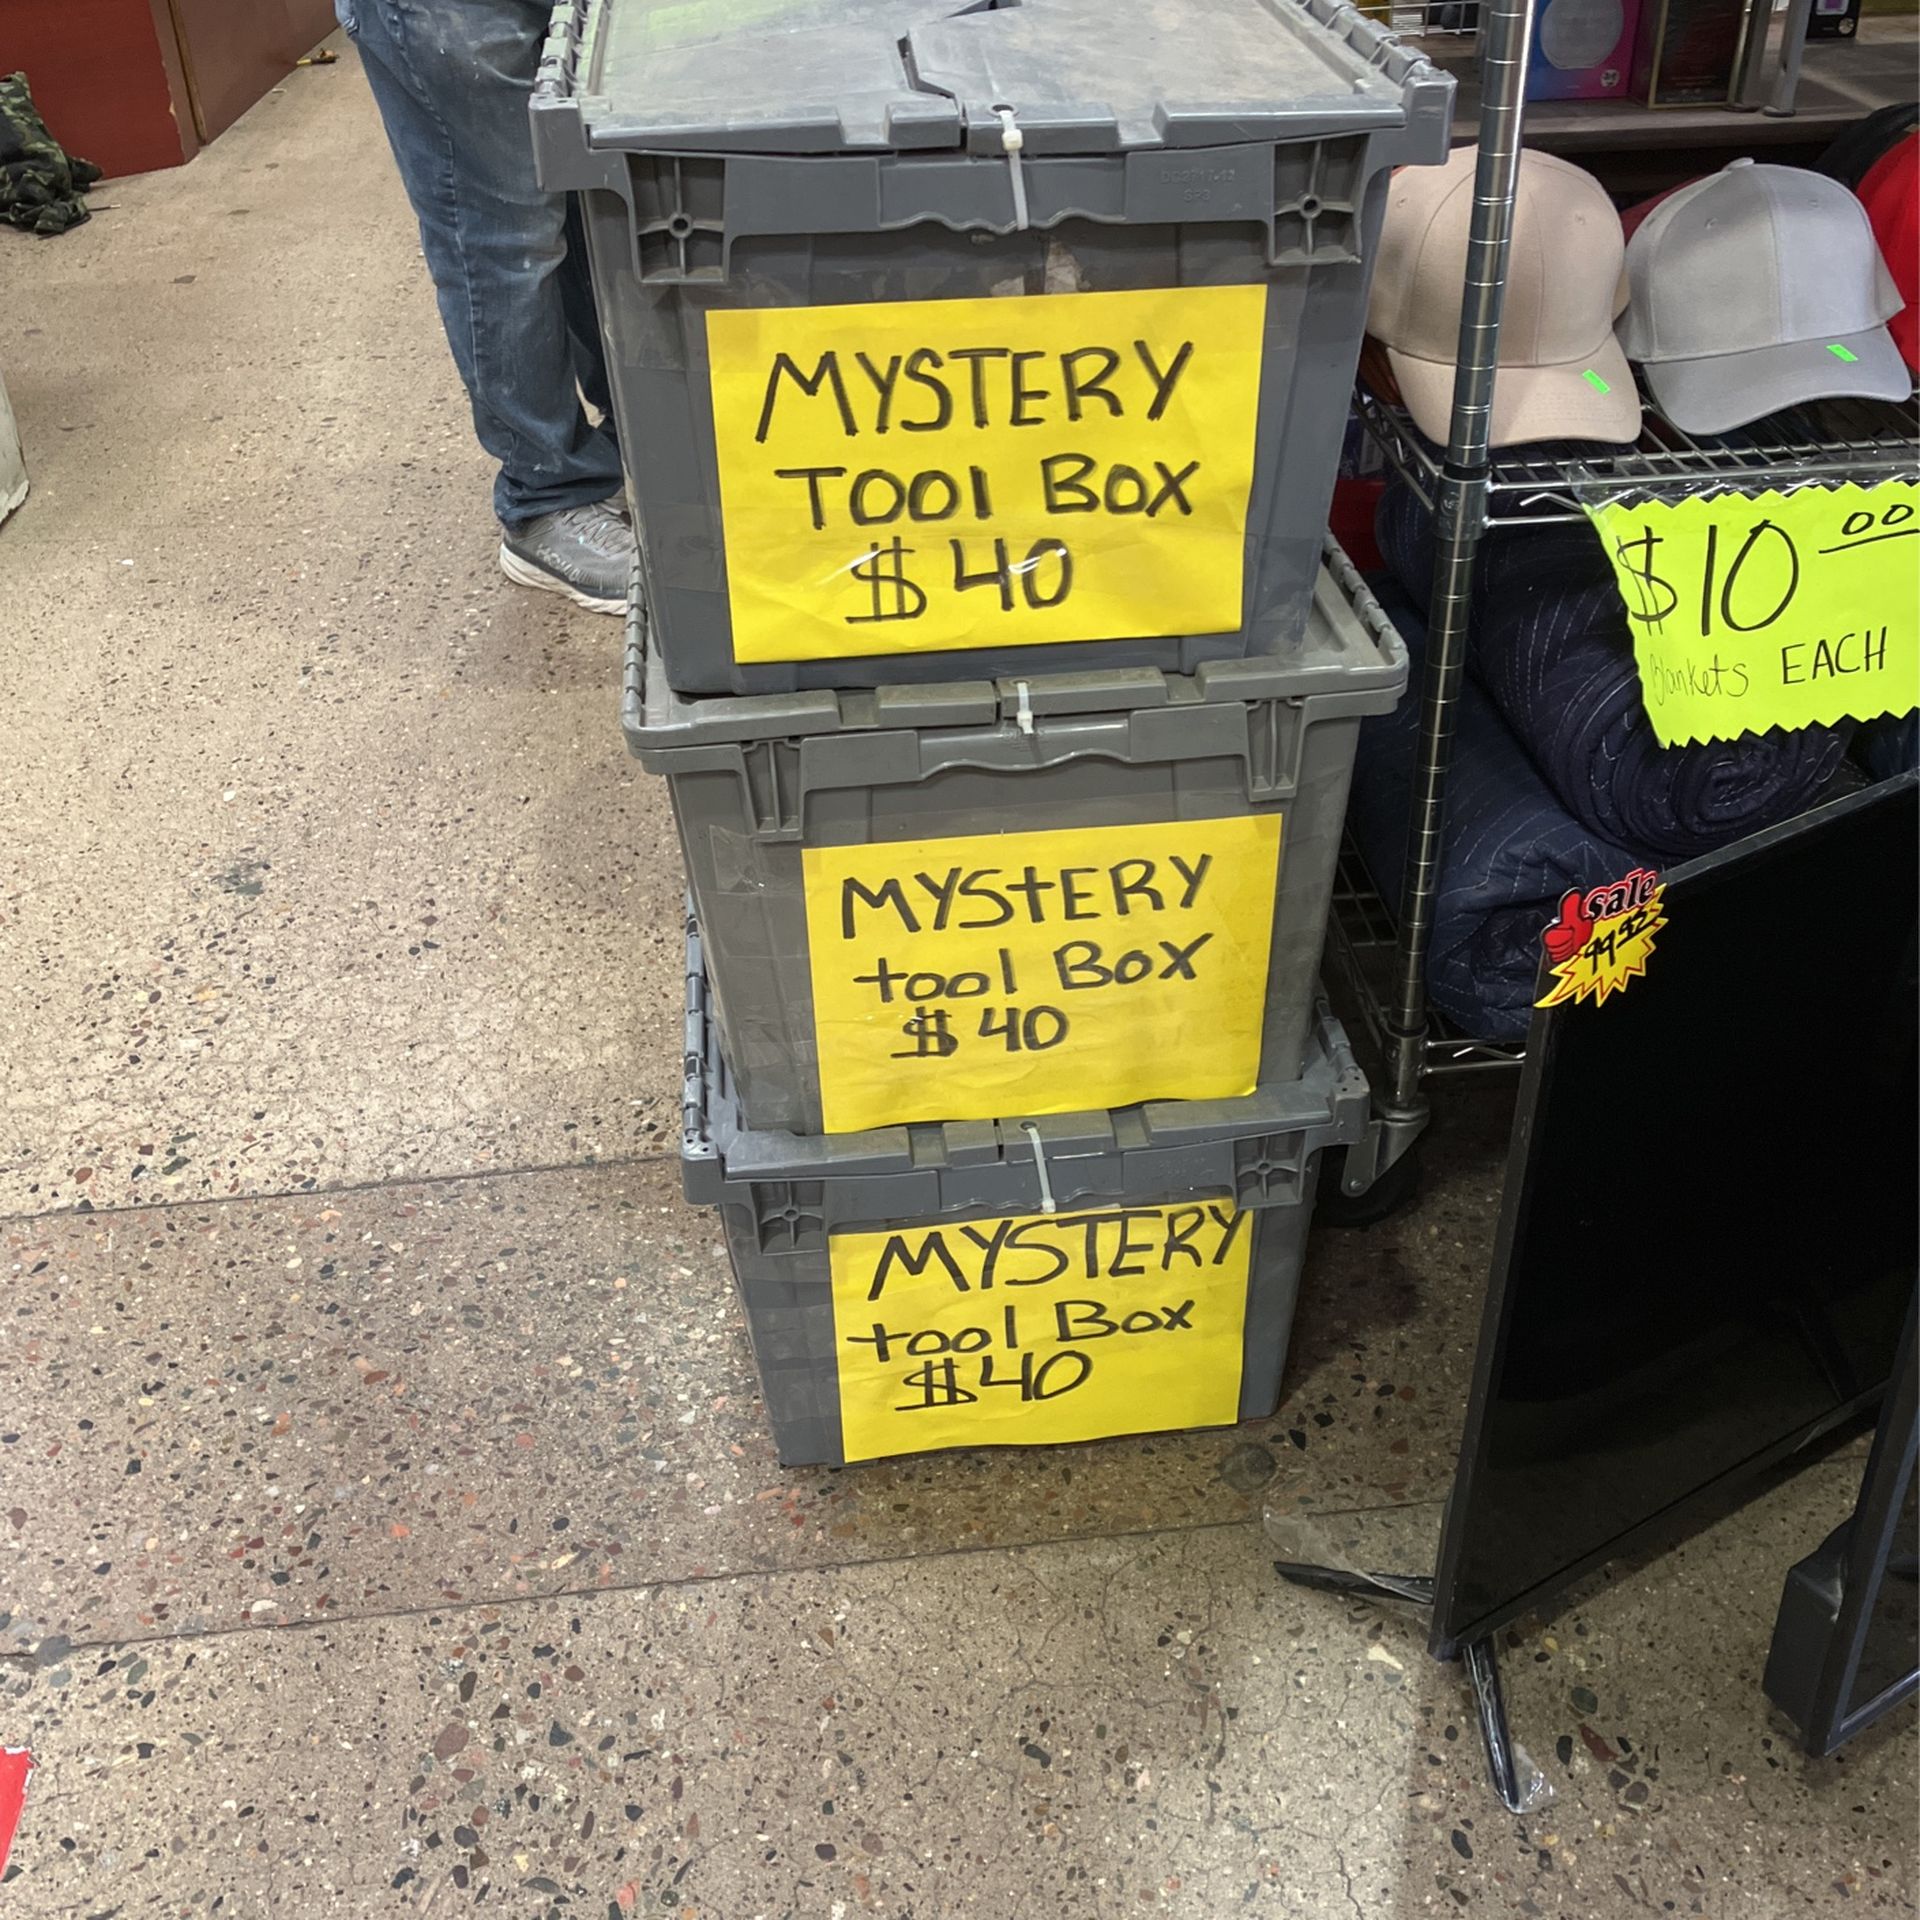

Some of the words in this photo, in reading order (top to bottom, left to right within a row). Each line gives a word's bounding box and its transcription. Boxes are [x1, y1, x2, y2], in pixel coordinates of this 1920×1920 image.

[755, 340, 1193, 443] MYSTERY
[1616, 519, 1800, 636] $10
[1781, 626, 1887, 685] EACH
[1586, 872, 1657, 920] sale
[868, 1205, 1246, 1301] MYSTERY
